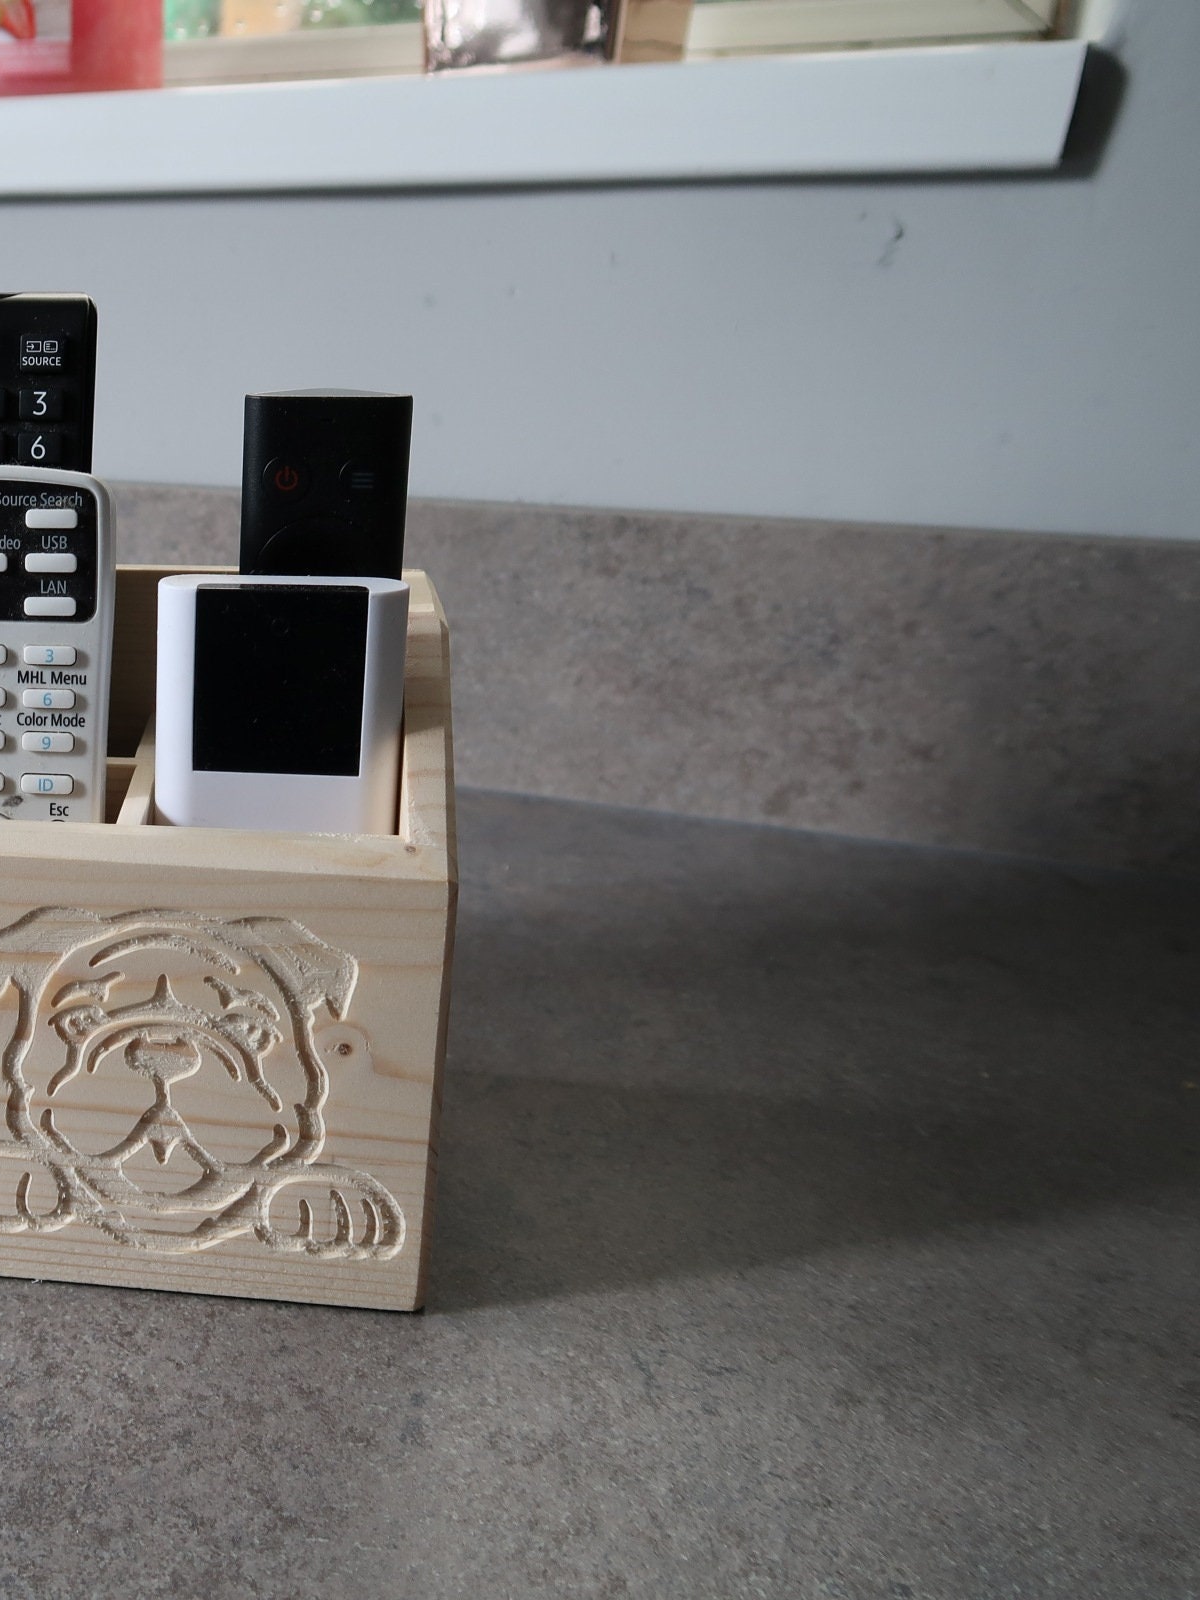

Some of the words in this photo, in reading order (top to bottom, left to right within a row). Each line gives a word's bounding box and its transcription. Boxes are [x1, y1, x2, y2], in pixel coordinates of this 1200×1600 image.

[22, 357, 61, 366] SOURCE
[33, 391, 47, 415] 3
[31, 436, 46, 459] 6
[40, 492, 82, 506] Search
[42, 536, 67, 549] USB
[41, 580, 66, 594] LAN
[45, 650, 54, 663] 3
[18, 671, 46, 684] MHL
[51, 672, 86, 685] Menu
[43, 693, 52, 706] 6
[17, 713, 48, 727] Color
[51, 713, 85, 727] Mode
[42, 736, 51, 749] 9
[39, 779, 53, 792] ID
[50, 803, 69, 816] Esc
